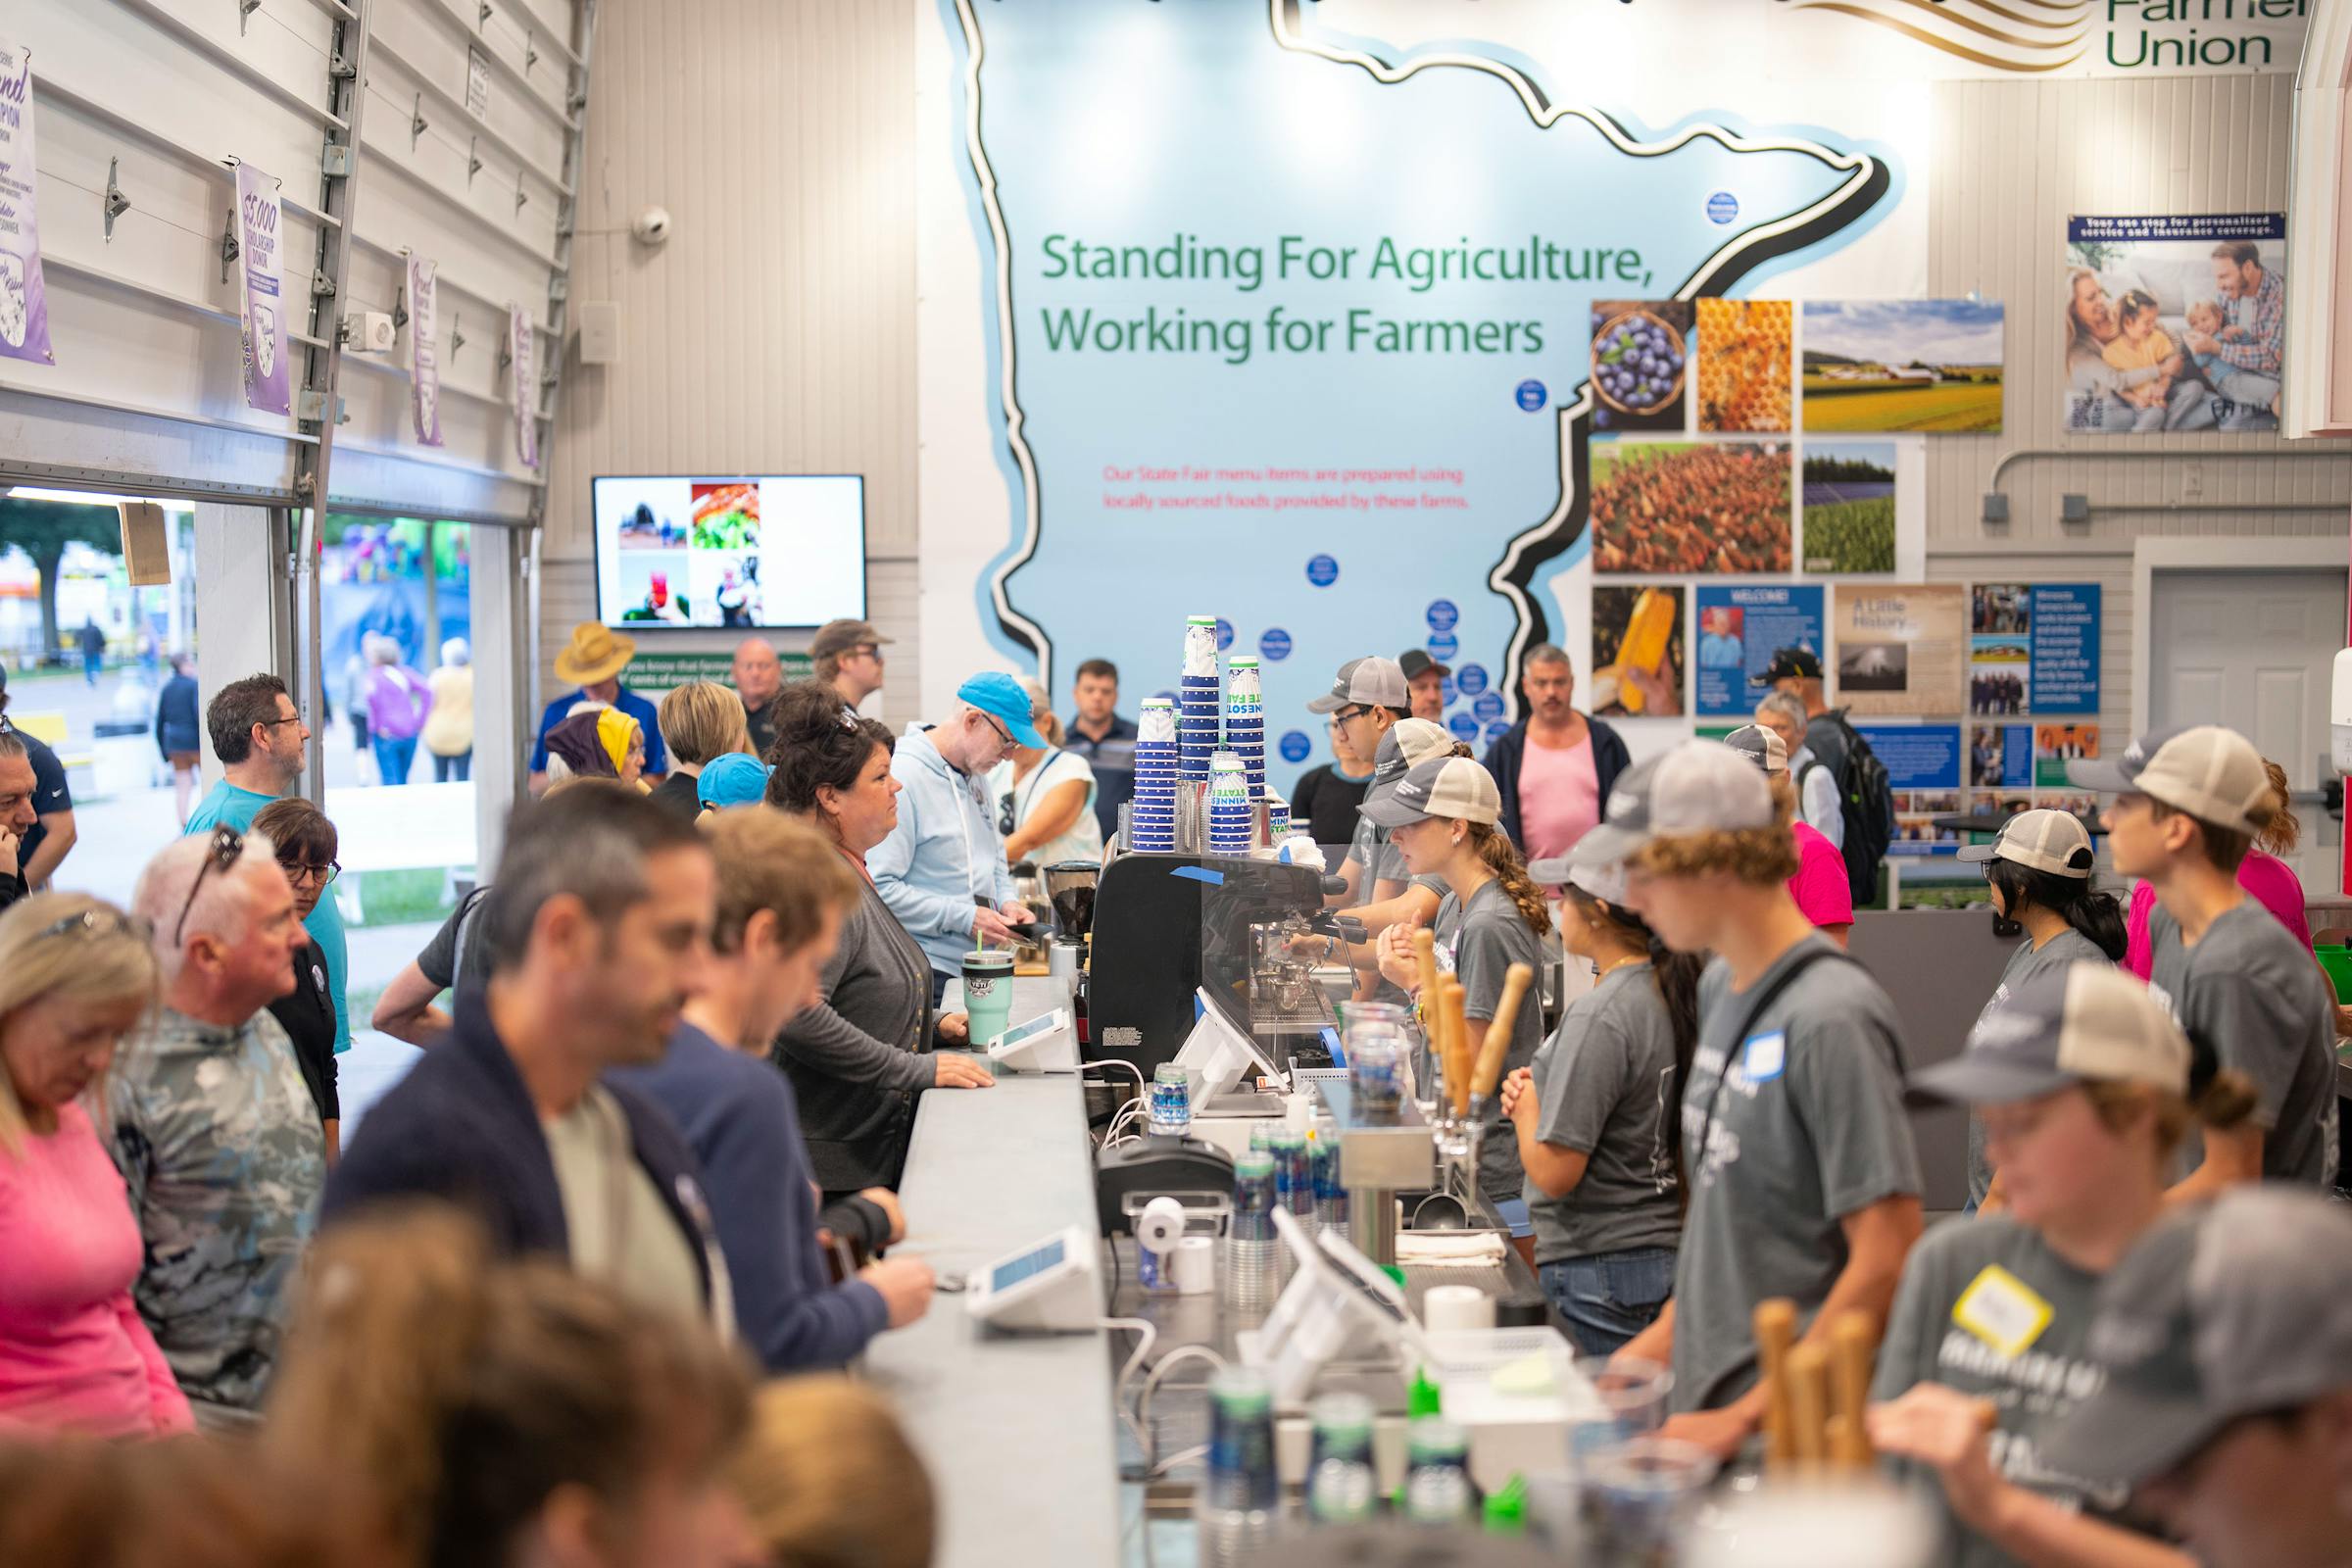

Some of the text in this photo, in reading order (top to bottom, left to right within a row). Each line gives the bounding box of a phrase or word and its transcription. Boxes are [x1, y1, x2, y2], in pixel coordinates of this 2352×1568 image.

[2107, 27, 2272, 67] Union
[2081, 227, 2124, 237] service
[2127, 226, 2149, 236] and
[2153, 226, 2214, 236] insurance
[2086, 216, 2271, 229] Your one stop for personalized
[1042, 232, 1653, 292] Standing For Agriculture,
[1042, 306, 1544, 364] Working for Farmers
[1103, 466, 1464, 485] Our State Fair menu items are prepared using
[1103, 493, 1153, 511] locally
[1158, 493, 1222, 508] sourced
[1226, 493, 1270, 508] foods
[1274, 493, 1347, 511] provided
[1350, 493, 1370, 511] by
[1374, 493, 1417, 508] these
